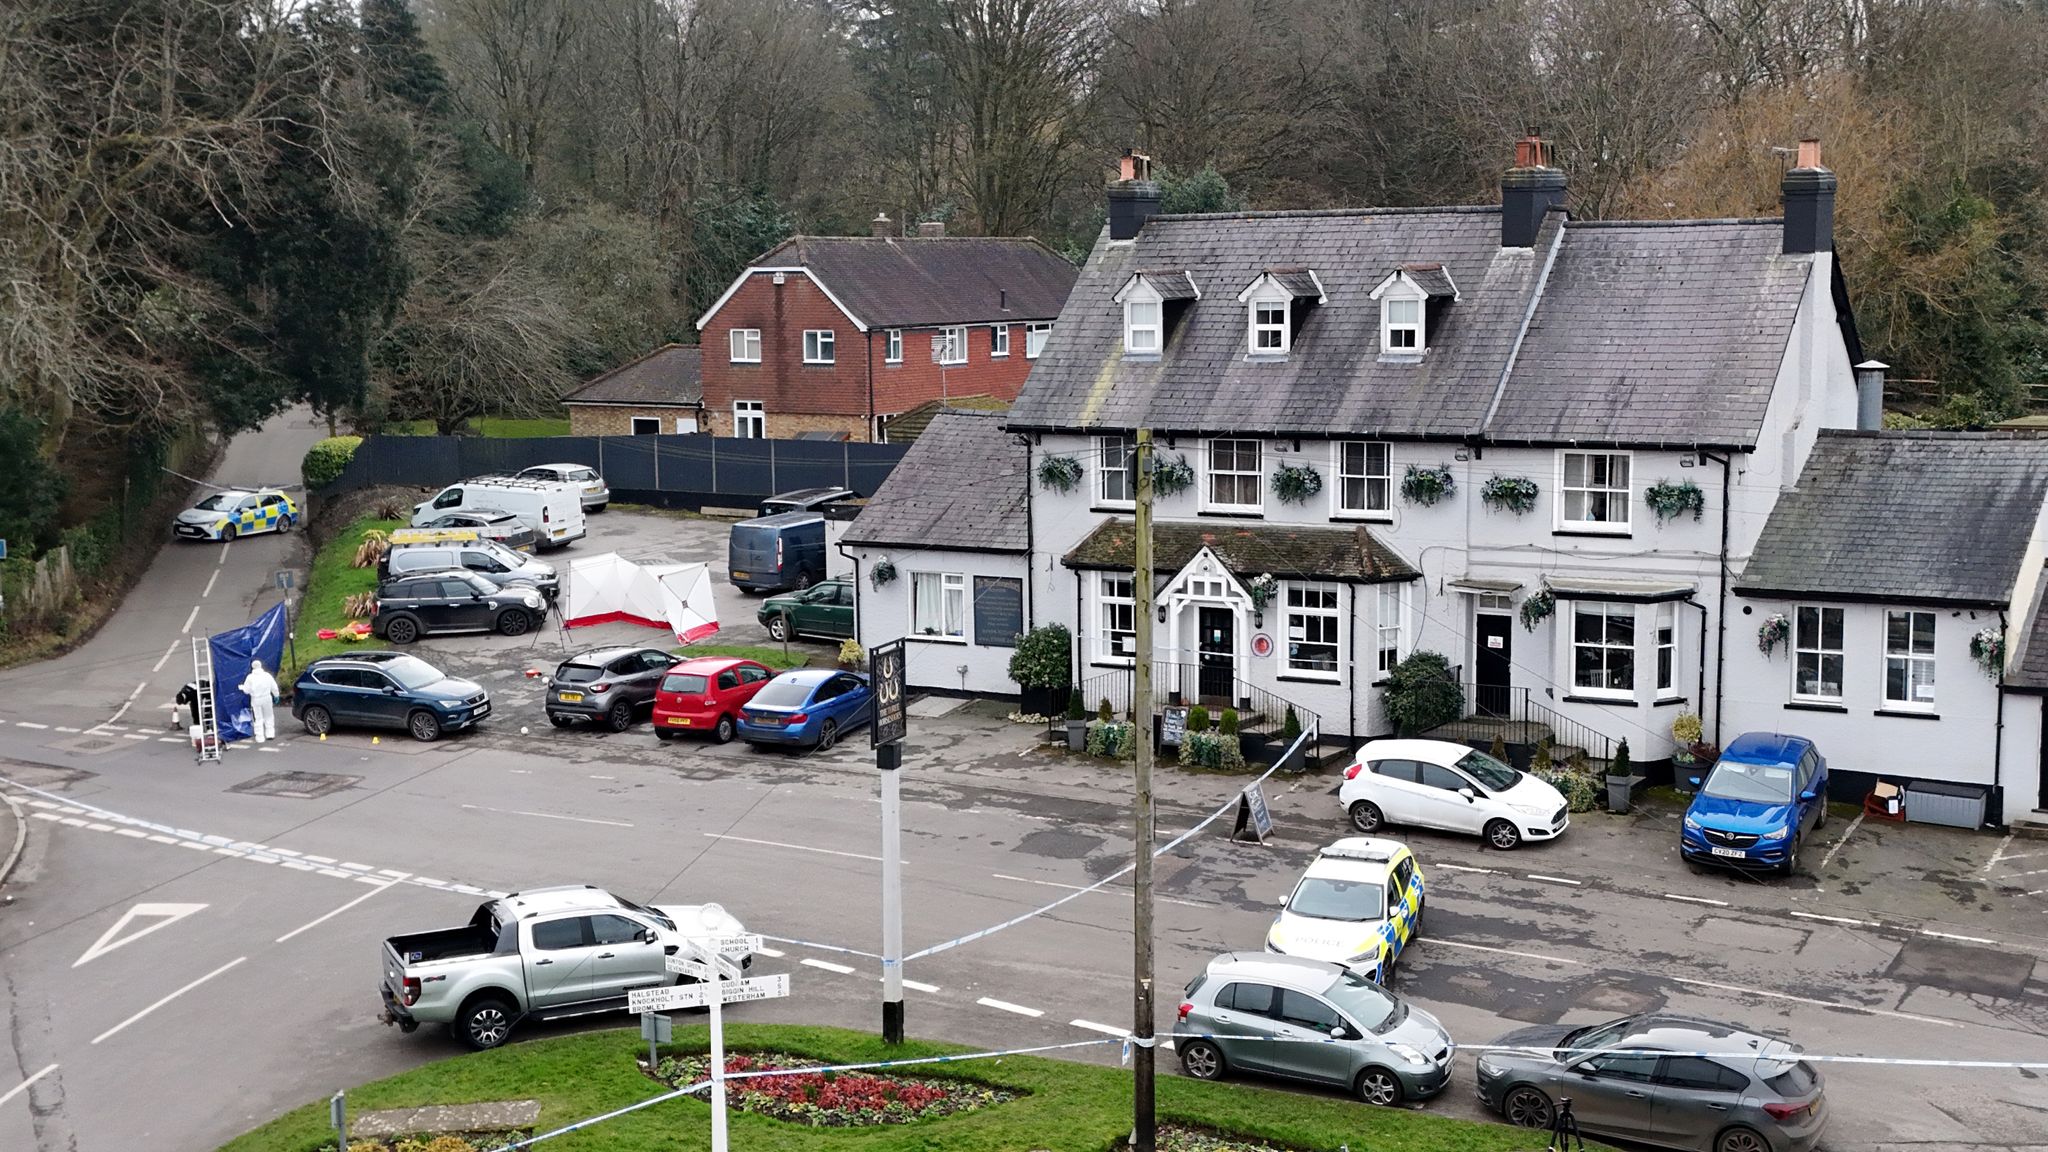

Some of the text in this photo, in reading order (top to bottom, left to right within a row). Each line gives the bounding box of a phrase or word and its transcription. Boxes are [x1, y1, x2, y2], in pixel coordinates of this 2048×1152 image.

[720, 938, 749, 946] SCHOOL
[720, 945, 749, 953] CHURCH
[631, 988, 669, 998] HALSTEAD
[721, 987, 744, 995] BIGGIN
[631, 995, 674, 1005] KNOCKHOLT
[722, 992, 766, 1002] WESTERHAM
[632, 1004, 666, 1013] BROMLEY
